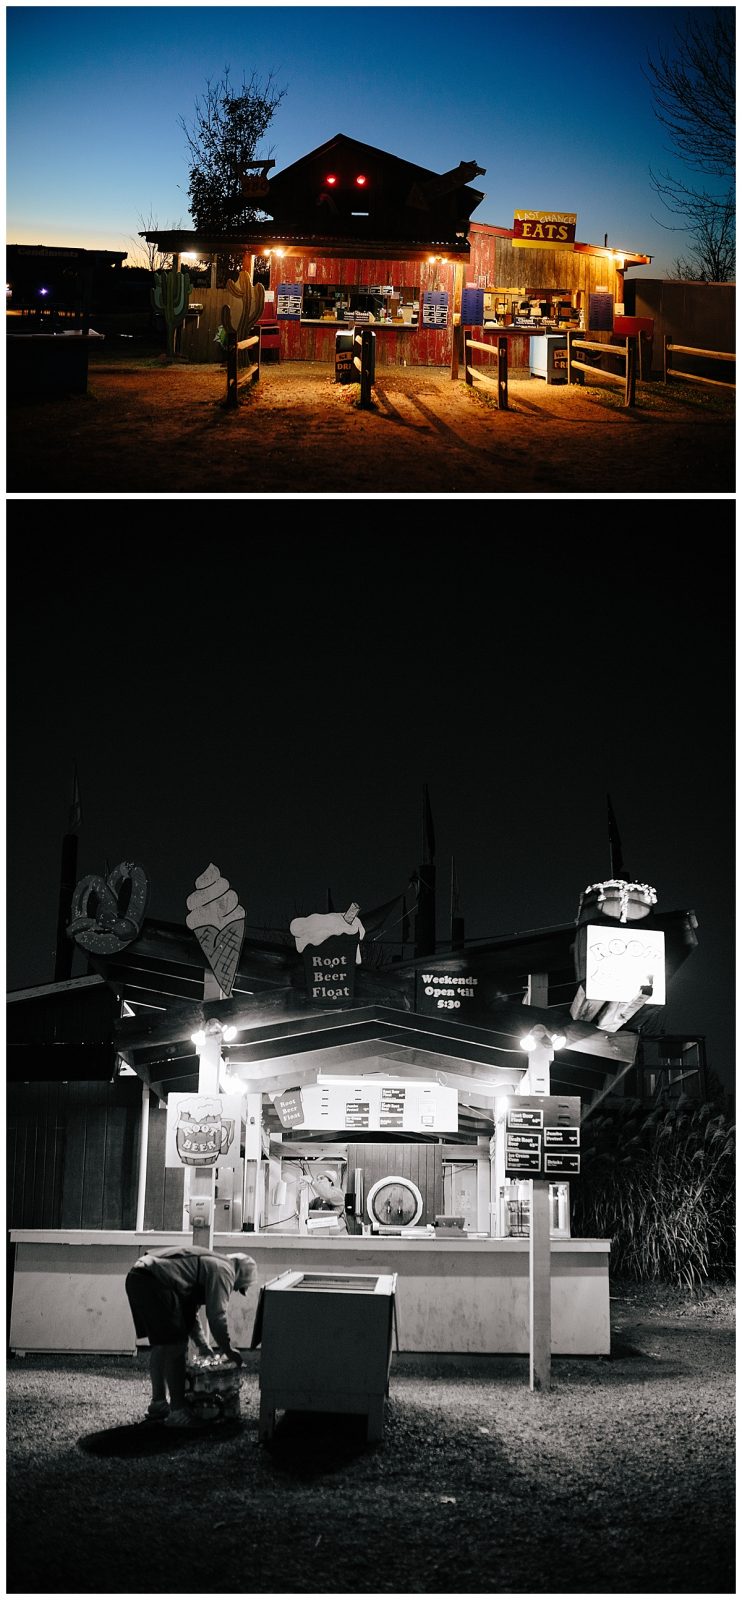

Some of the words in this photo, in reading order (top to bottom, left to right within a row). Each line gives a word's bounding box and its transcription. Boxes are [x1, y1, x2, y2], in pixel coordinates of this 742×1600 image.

[517, 211, 540, 222] LAST
[539, 214, 577, 226] CHANCE!
[521, 222, 569, 241] EATS
[312, 956, 347, 967] Root
[314, 972, 347, 982] Beer
[421, 974, 478, 985] Weekends
[312, 986, 350, 998] Float
[424, 986, 455, 998] Open
[437, 999, 461, 1010] 5:30
[279, 1099, 297, 1108] Root
[182, 1124, 218, 1137] ROOT
[182, 1139, 217, 1152] BEER
